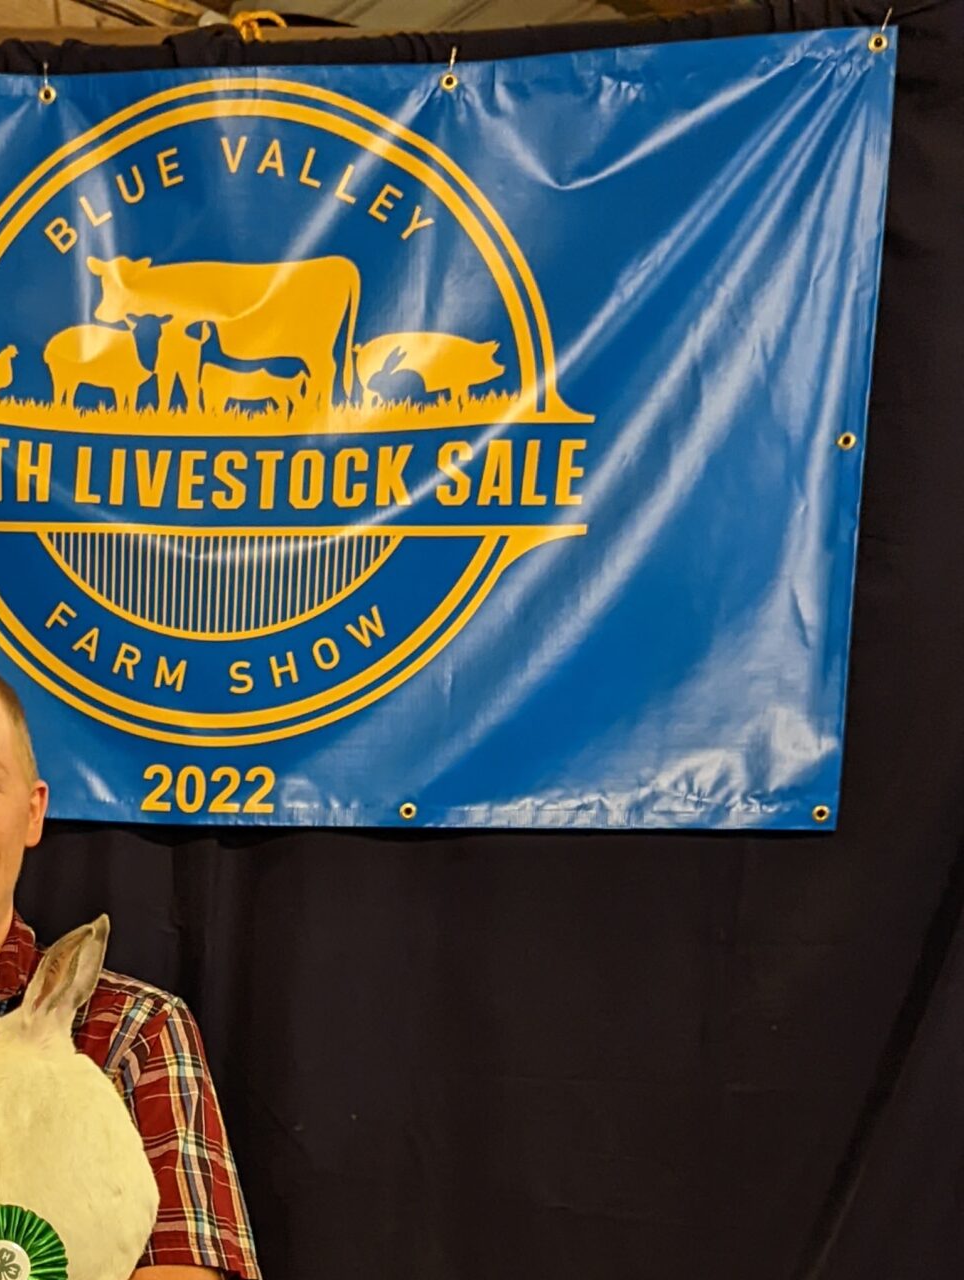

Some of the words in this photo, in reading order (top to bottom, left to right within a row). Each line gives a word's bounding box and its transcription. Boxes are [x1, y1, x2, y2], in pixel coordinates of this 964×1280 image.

[44, 147, 184, 254] BLUE
[221, 136, 434, 240] VALLEY
[75, 444, 413, 510] LIVESTOCK
[436, 439, 586, 506] SALE
[45, 602, 187, 692] FARM
[229, 605, 387, 694] SHOW
[140, 764, 275, 814] 2022
